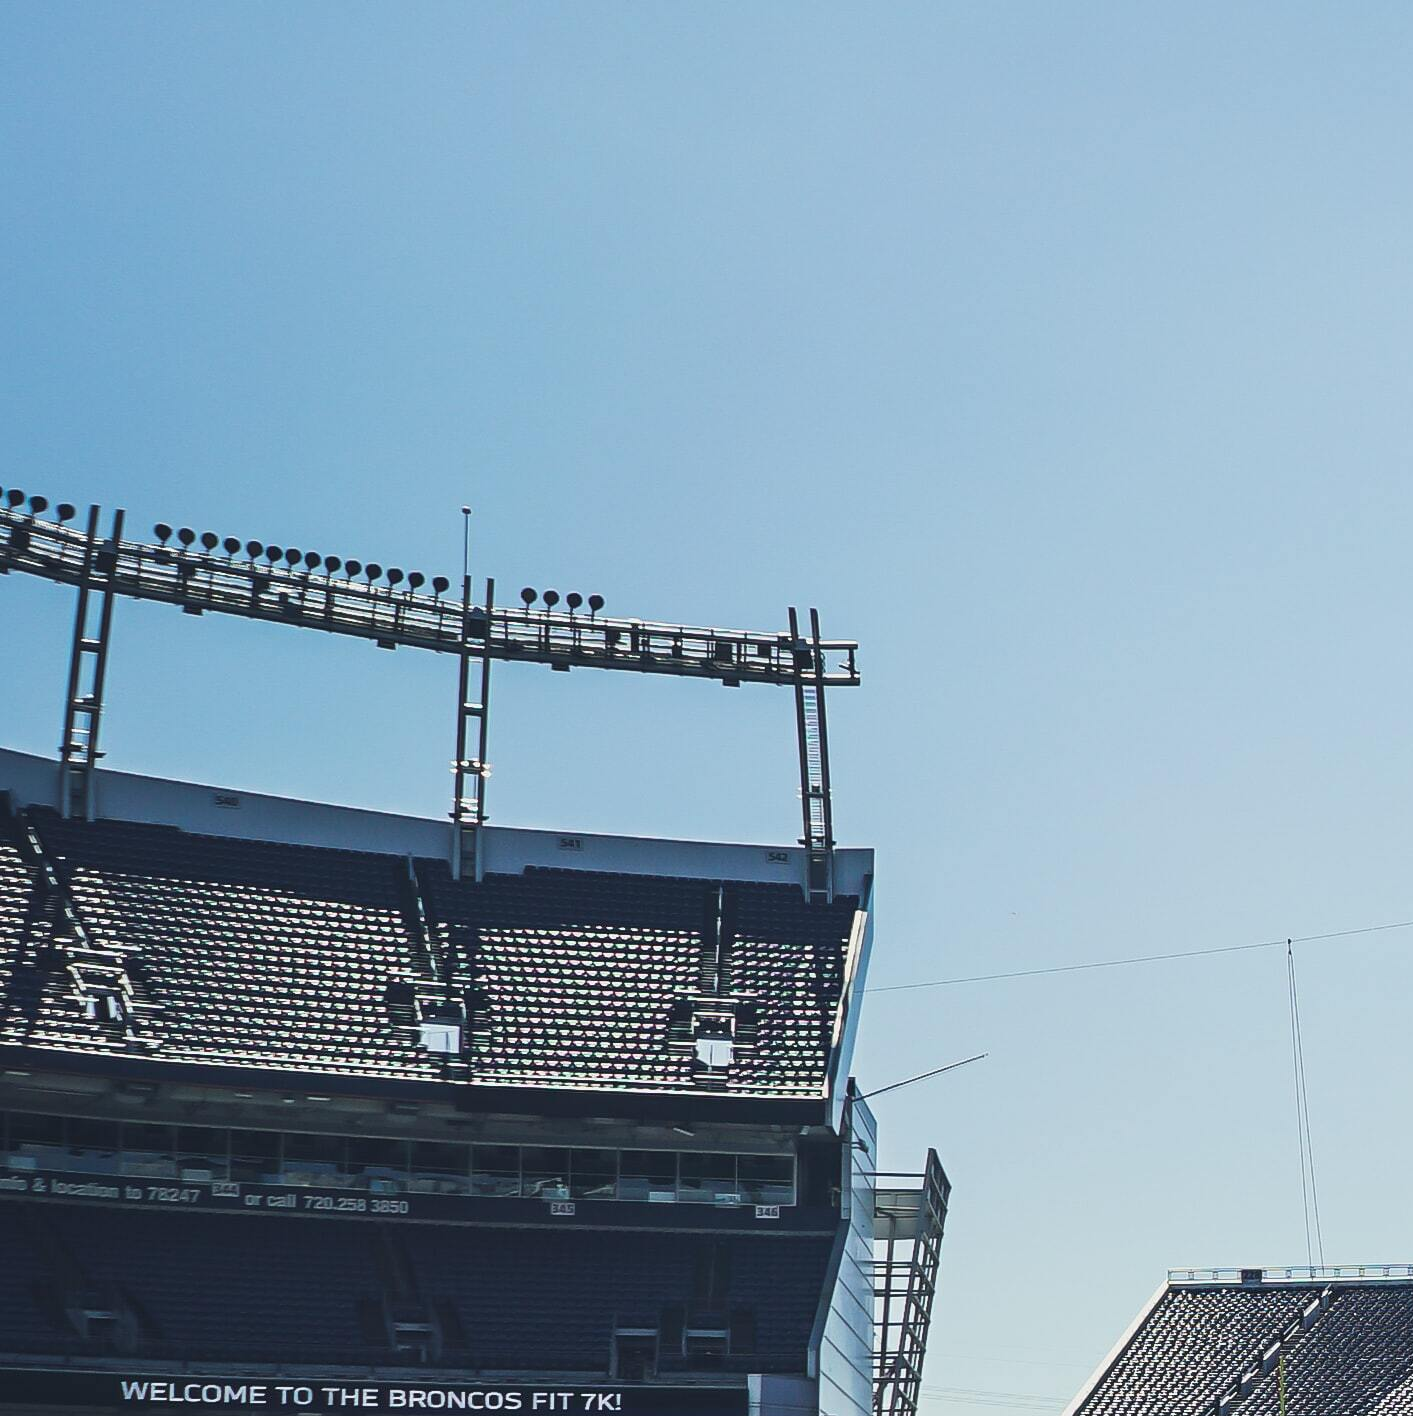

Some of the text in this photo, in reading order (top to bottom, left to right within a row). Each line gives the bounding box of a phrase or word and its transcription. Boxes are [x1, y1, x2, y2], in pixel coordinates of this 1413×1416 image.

[768, 852, 788, 862] 542
[244, 1195, 262, 1206] or
[267, 1194, 296, 1208] call
[120, 1381, 622, 1411] WELCOME TO THE BRONCOS FIT 7K!
